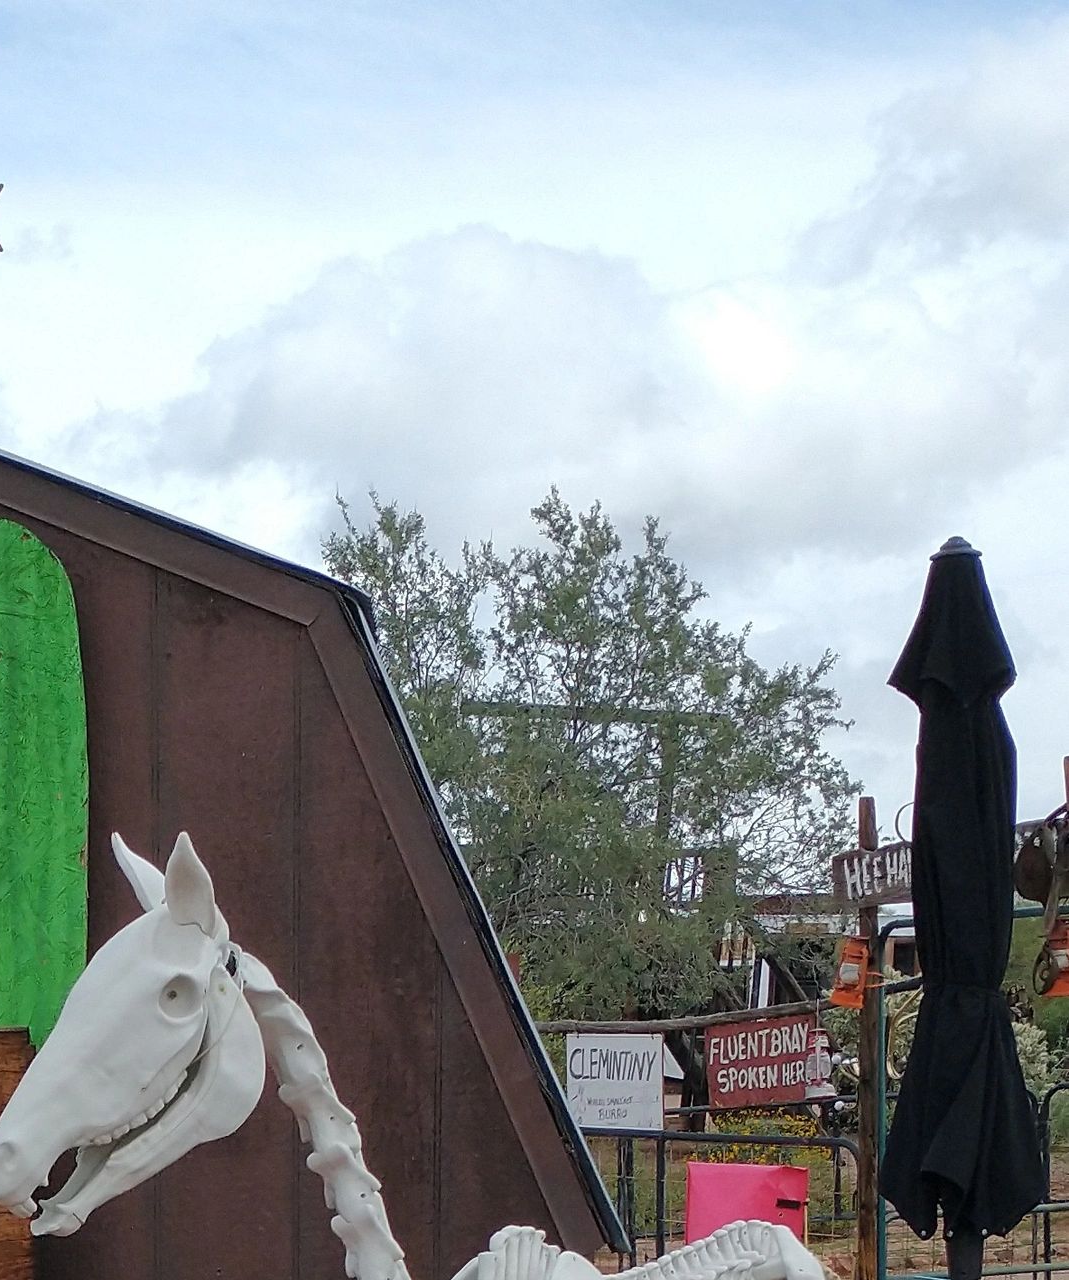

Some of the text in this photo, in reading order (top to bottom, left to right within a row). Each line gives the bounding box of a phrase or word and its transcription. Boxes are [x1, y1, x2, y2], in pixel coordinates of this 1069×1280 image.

[844, 854, 882, 899] HEE
[710, 1022, 809, 1065] FLUENT BRAY
[717, 1063, 778, 1093] SPOKEN
[599, 1108, 628, 1120] BURRO
